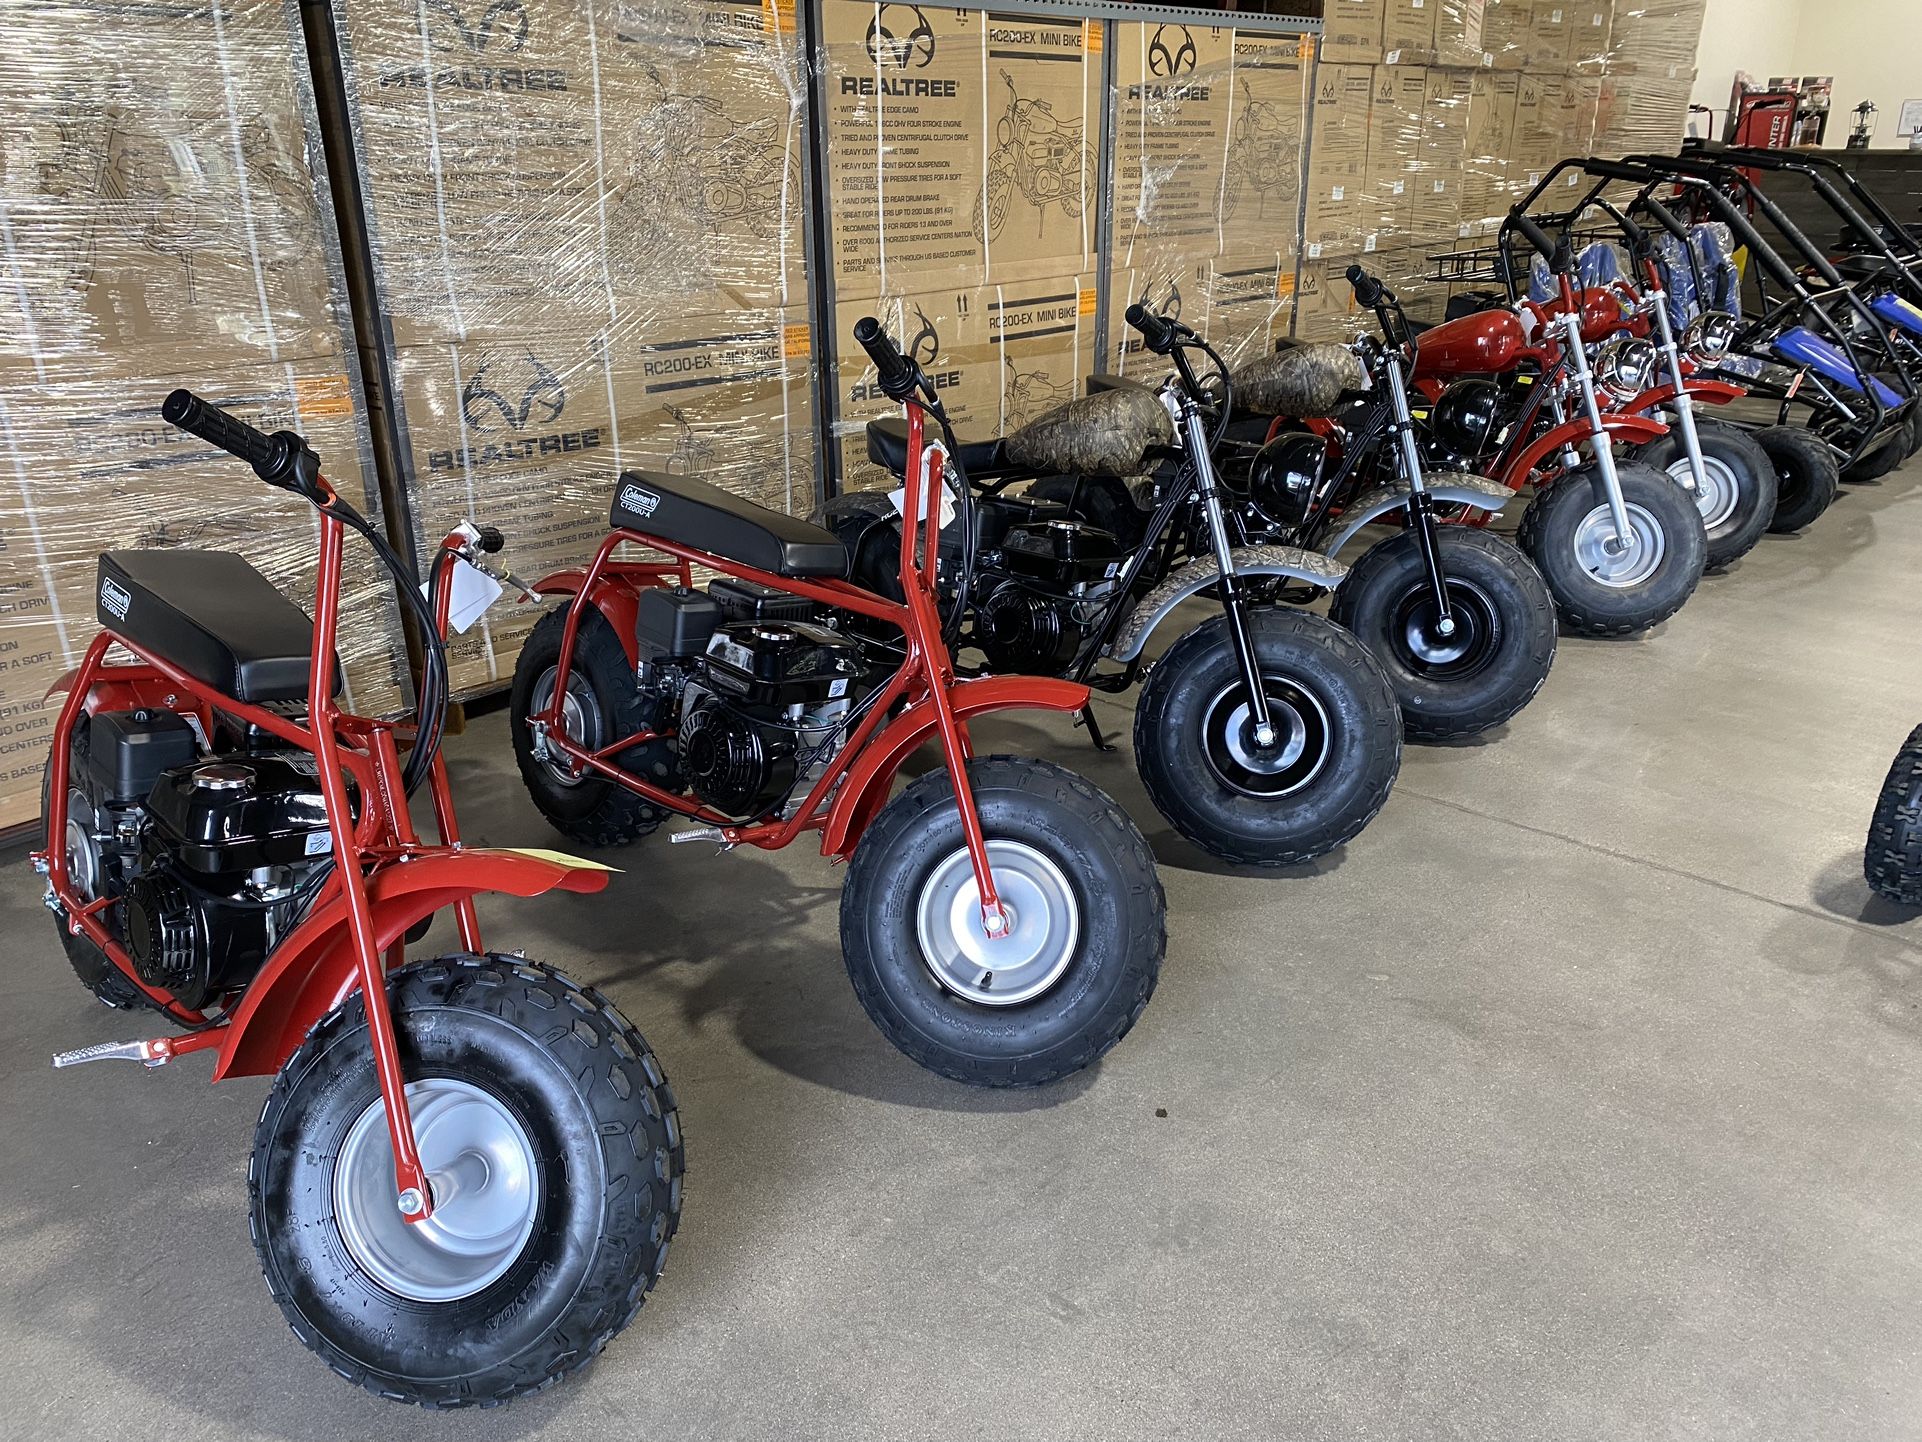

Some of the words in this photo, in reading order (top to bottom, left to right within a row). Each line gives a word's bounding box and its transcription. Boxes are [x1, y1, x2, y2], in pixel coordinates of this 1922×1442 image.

[990, 28, 1036, 44] RC200-EX
[1041, 32, 1060, 46] MINI
[1063, 34, 1082, 46] BIKE
[841, 76, 956, 97] REALTREE
[860, 196, 889, 204] OPERAED
[843, 223, 887, 232] RECOMMENDD
[875, 236, 908, 244] ATHORIZED
[931, 232, 953, 240] CENTERS
[843, 258, 862, 266] PARTS
[933, 252, 949, 260] BASED
[950, 249, 976, 258] CUSTOMER
[844, 265, 866, 273] SERVICE
[1037, 309, 1056, 322] MINI
[1058, 306, 1076, 319] BIKE
[644, 355, 712, 376] RC200-EX
[852, 370, 960, 400] REREE
[959, 416, 973, 424] DRIVE
[852, 447, 867, 455] HEAV
[625, 488, 650, 505] Coleman
[524, 511, 553, 522] TUBING
[620, 502, 650, 518] CT200U-A
[553, 516, 600, 531] SUSPENSION
[557, 536, 576, 546] TIRES
[578, 532, 593, 542] FOR
[594, 531, 600, 539] A
[539, 559, 563, 569] DRUM
[104, 581, 123, 604] Coleman
[20, 597, 50, 610] DRIV
[12, 658, 20, 668] A
[23, 651, 52, 665] SOFT
[16, 717, 48, 731] OVER
[1, 734, 54, 754] CENTERS
